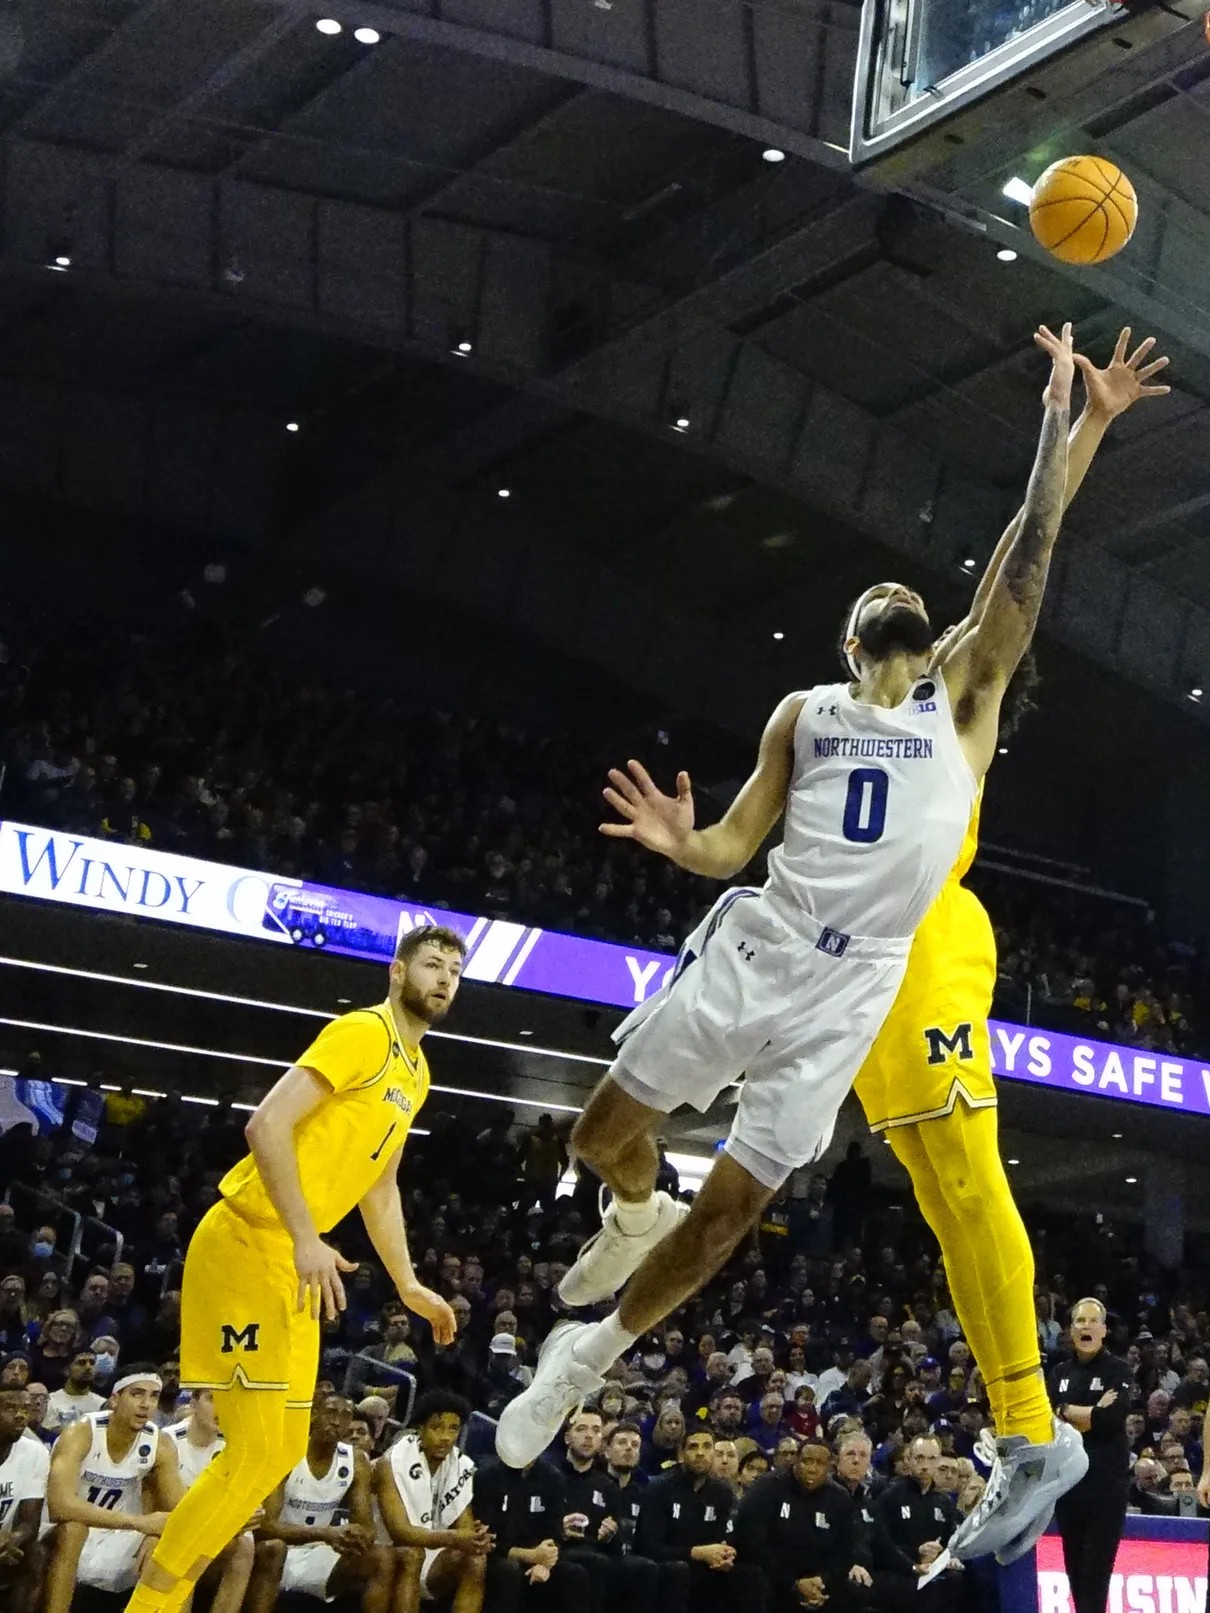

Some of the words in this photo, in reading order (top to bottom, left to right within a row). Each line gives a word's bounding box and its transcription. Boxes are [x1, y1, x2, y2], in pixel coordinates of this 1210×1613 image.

[814, 737, 934, 760] NORTHWESTERN
[842, 768, 890, 844] 0
[13, 829, 206, 914] WINDY
[924, 1023, 973, 1065] M
[990, 1028, 1052, 1077] YS
[1071, 1045, 1184, 1104] SAFE
[370, 1121, 397, 1161] 1
[221, 1323, 260, 1354] M
